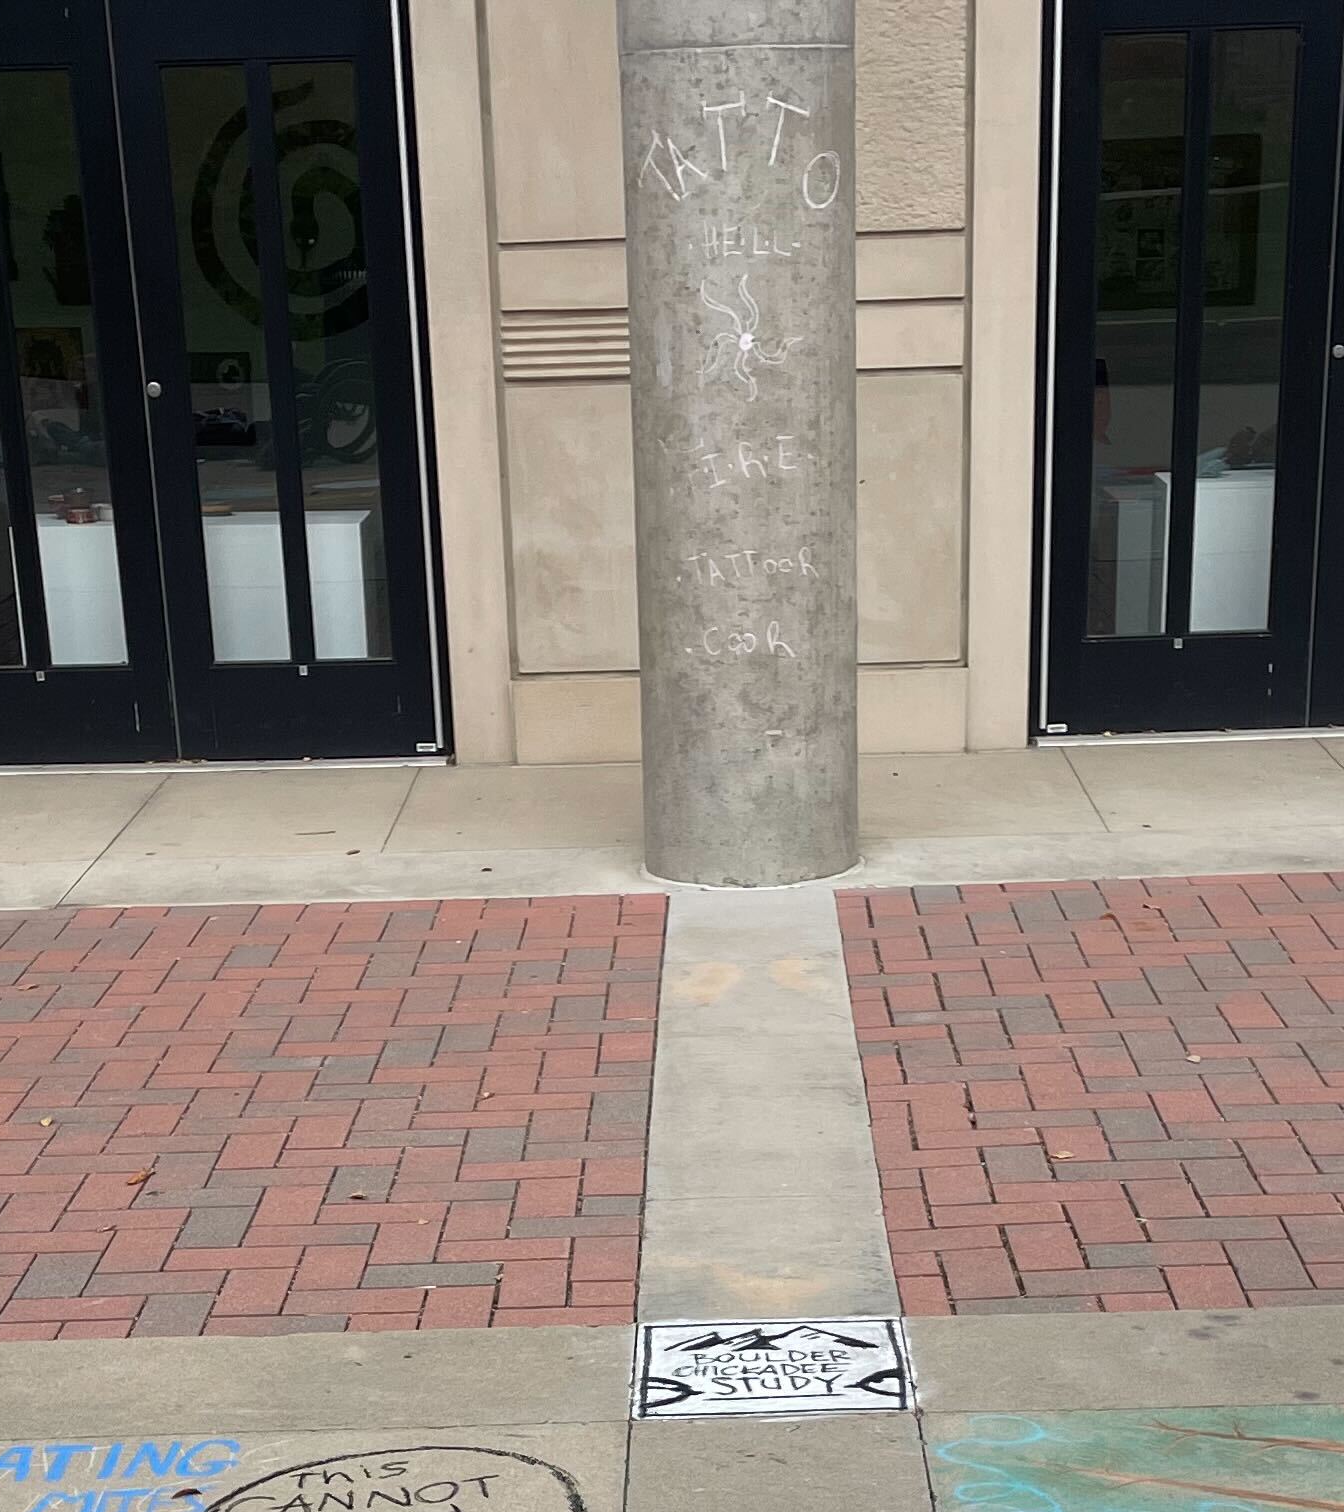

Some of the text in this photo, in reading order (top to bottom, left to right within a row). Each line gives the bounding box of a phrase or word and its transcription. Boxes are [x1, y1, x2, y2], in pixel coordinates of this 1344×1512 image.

[693, 1350, 850, 1364] BOULDER
[671, 1362, 846, 1377] CHICKADEE
[711, 1374, 843, 1395] STUDY
